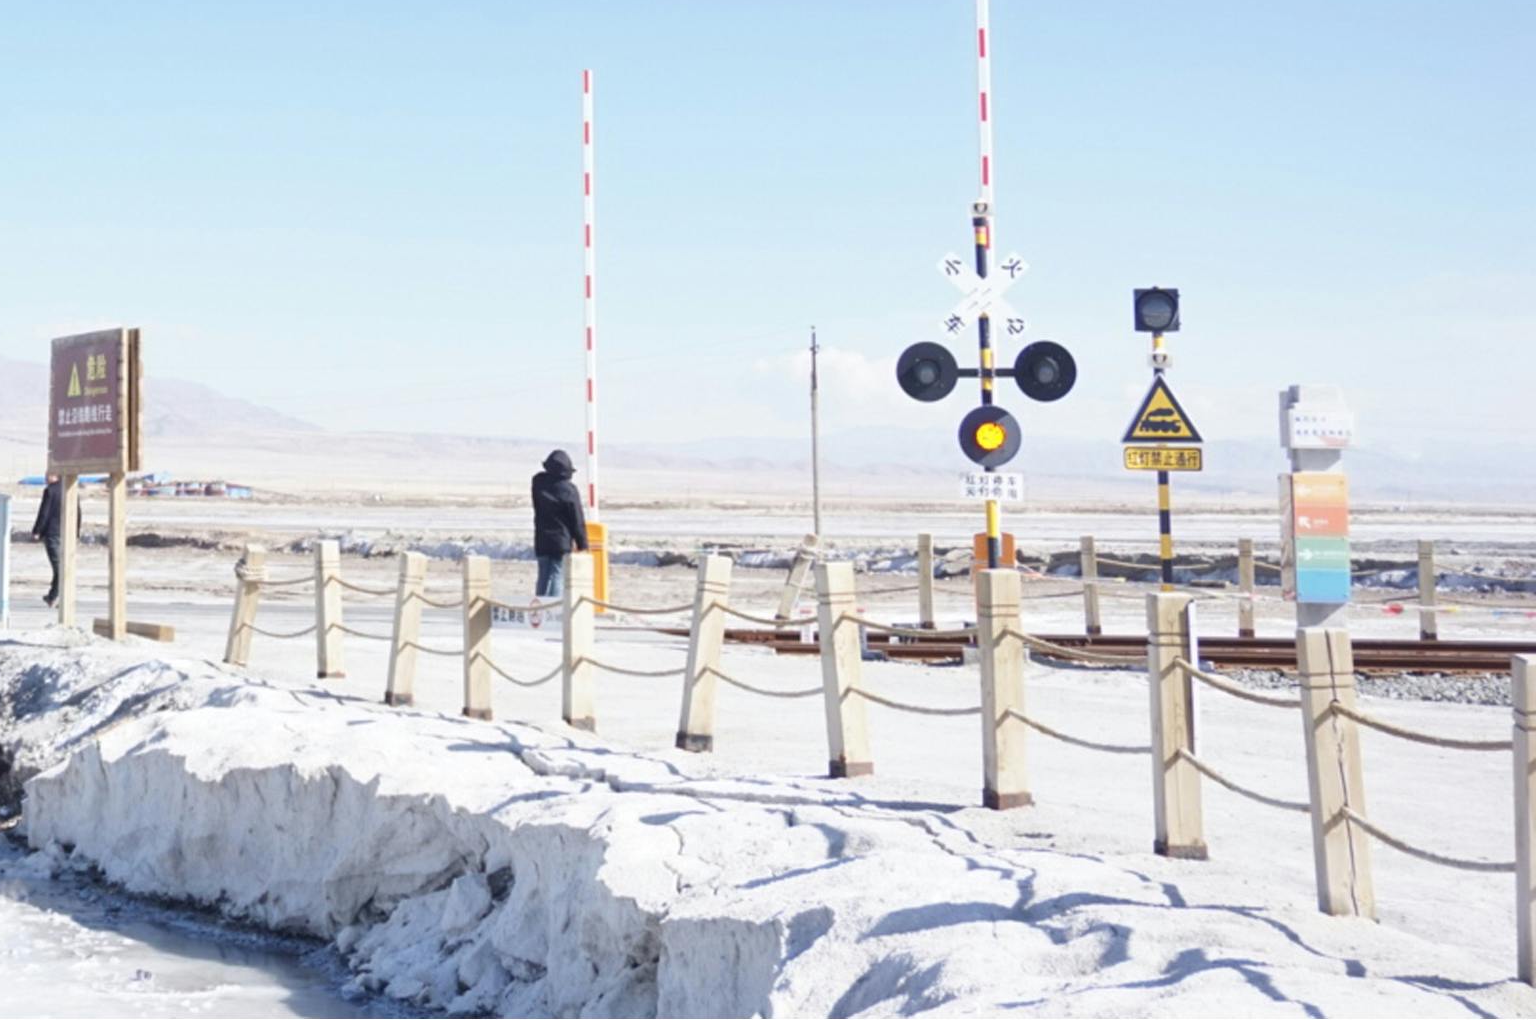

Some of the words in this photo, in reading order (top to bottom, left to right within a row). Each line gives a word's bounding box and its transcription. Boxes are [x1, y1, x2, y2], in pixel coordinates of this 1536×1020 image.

[1128, 451, 1198, 467] 红灯禁止通行
